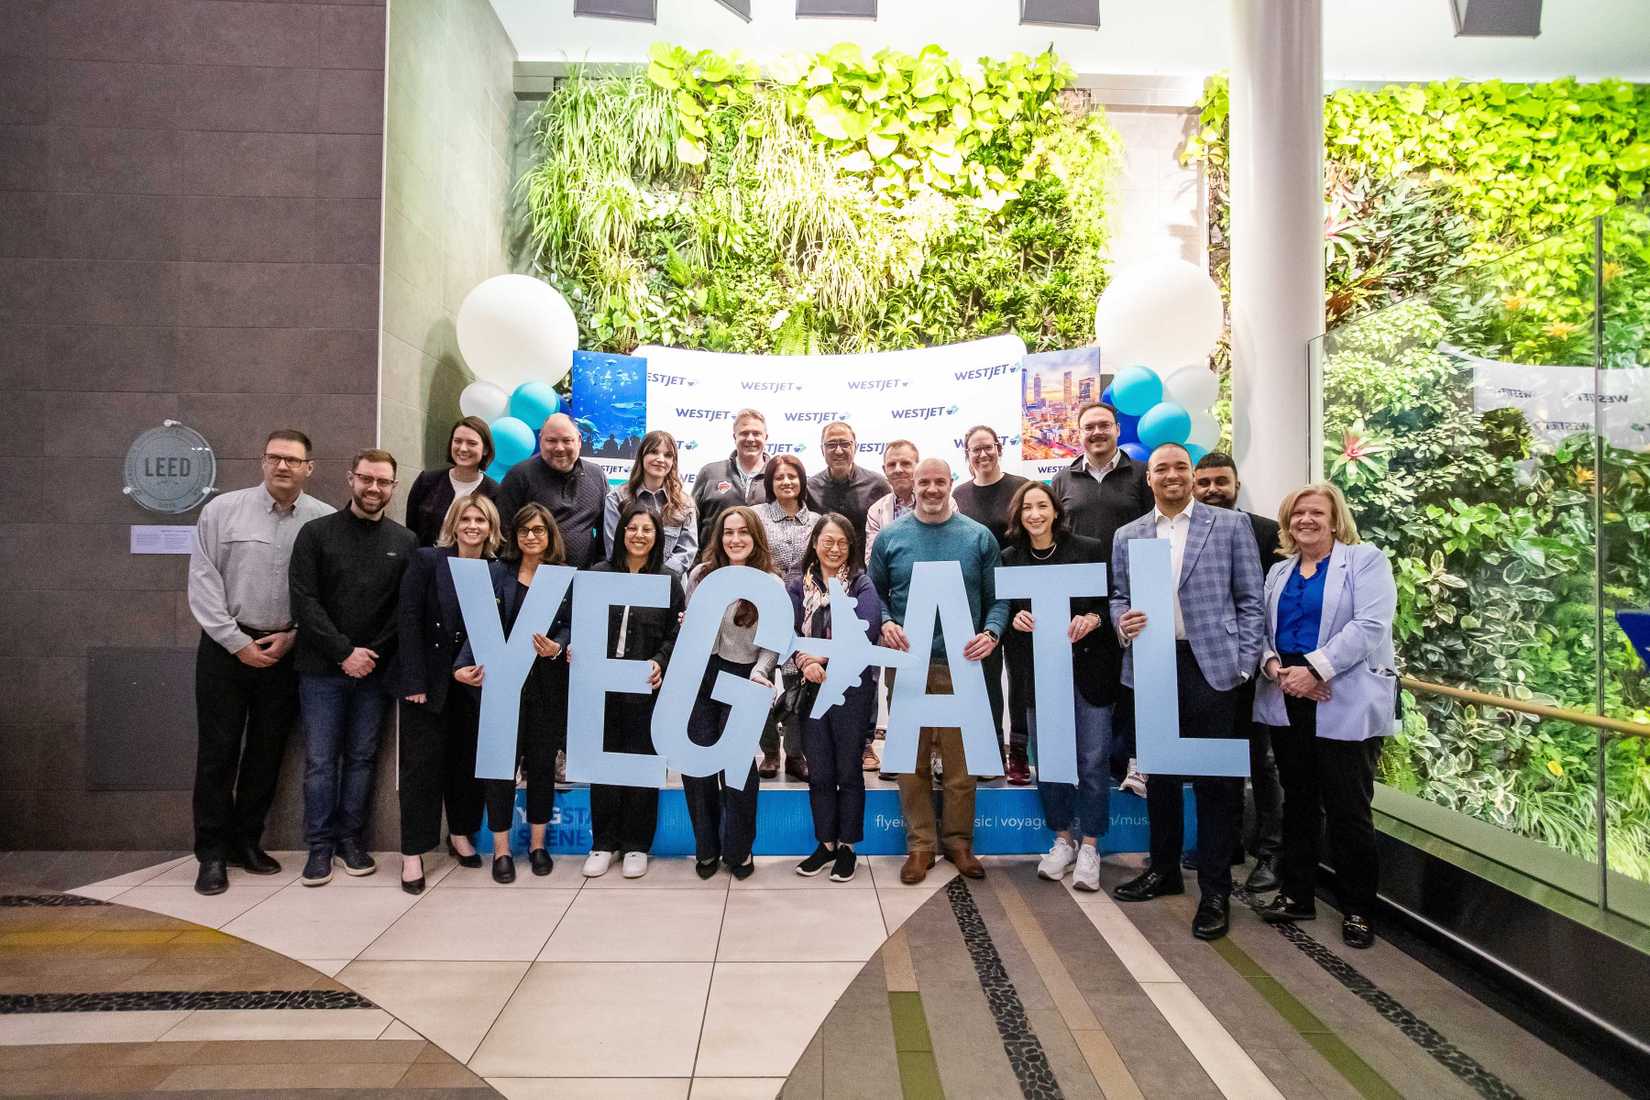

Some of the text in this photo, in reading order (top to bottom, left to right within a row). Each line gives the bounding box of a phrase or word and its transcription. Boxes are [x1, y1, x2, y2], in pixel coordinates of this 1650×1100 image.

[647, 372, 687, 387] ESTJET
[954, 364, 1009, 381] WESTJET
[740, 381, 795, 393] WESTJET
[848, 379, 902, 391] WESTJET
[675, 407, 731, 421] WESTJET
[784, 412, 838, 424] WESTJET
[891, 406, 946, 420] WESTJET
[144, 457, 191, 477] LEED
[447, 538, 1251, 792] YEG ATL
